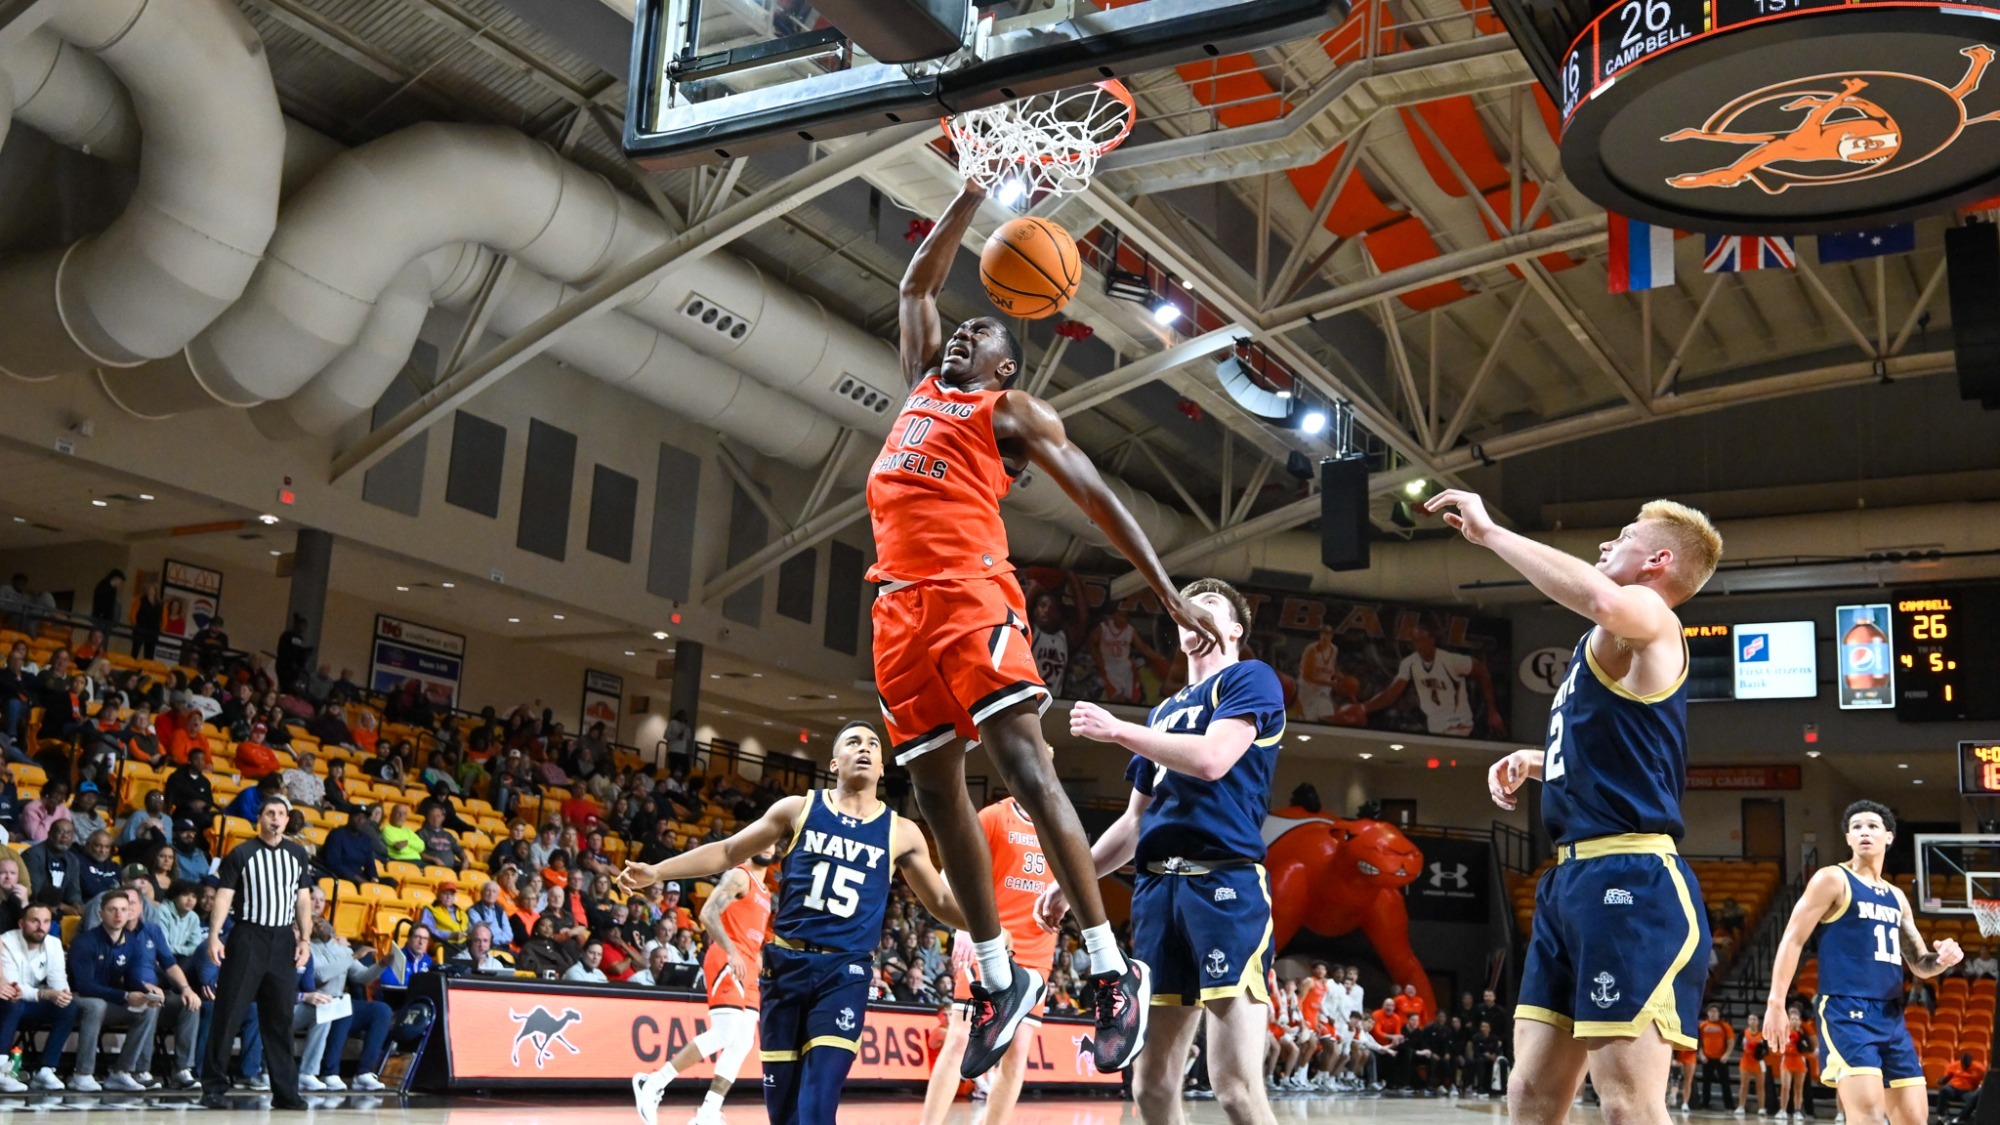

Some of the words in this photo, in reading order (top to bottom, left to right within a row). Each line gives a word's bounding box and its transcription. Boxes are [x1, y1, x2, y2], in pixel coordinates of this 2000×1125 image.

[1620, 0, 1671, 48] 26
[1605, 23, 1692, 76] CAMPBELL
[1562, 50, 1580, 105] 16
[899, 416, 934, 448] 10
[1899, 599, 1952, 612] CAMPBELL
[1913, 614, 1948, 640] 26
[1739, 667, 1763, 676] First
[1766, 666, 1813, 675] Citizens
[1900, 654, 1913, 668] 4
[1739, 680, 1767, 689] Bank
[1945, 684, 1953, 702] 1
[1546, 710, 1566, 782] 2
[803, 829, 886, 869] NAVY
[1023, 851, 1047, 875] 35
[803, 860, 867, 919] 15
[1873, 924, 1902, 966] 11
